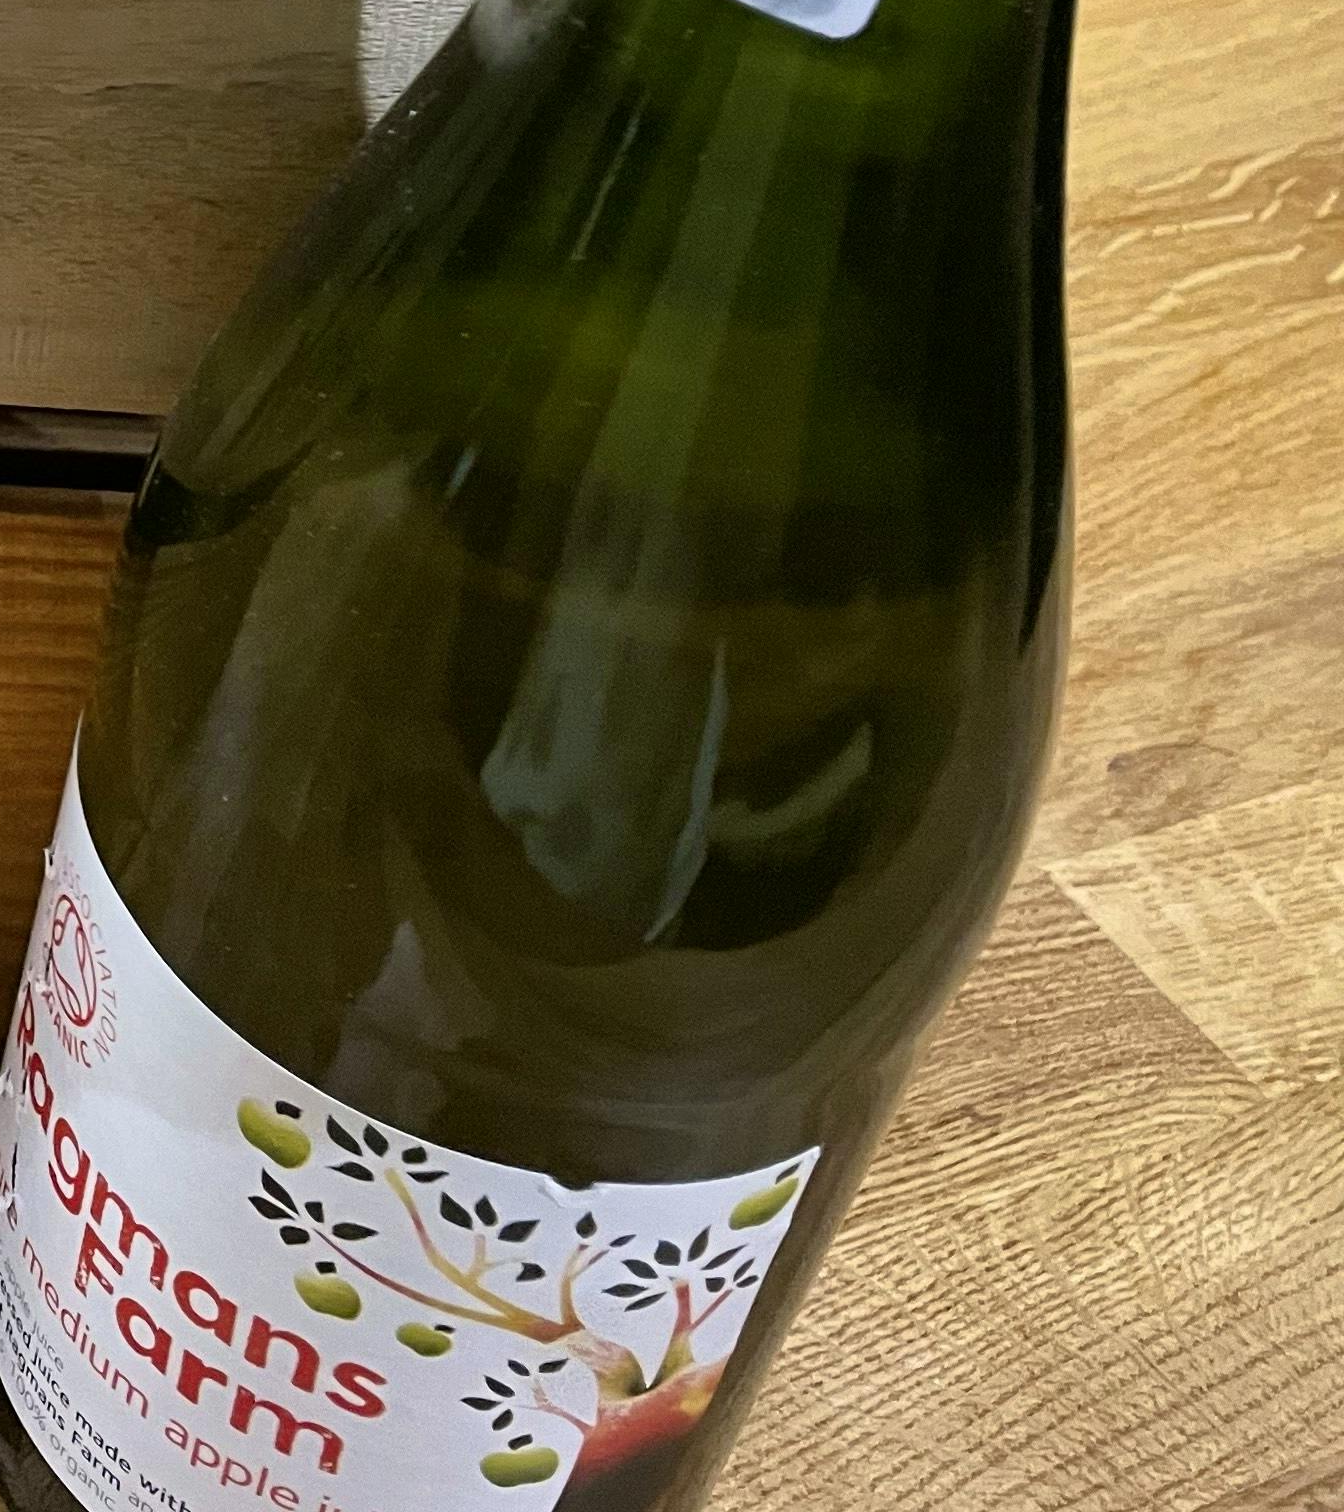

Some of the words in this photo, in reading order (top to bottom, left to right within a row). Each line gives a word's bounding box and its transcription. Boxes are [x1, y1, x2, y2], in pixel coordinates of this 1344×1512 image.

[17, 982, 389, 1418] Ragmans
[5, 1319, 66, 1431] Ragmans
[71, 1430, 121, 1491] Farm
[21, 1237, 148, 1419] medium
[164, 1418, 300, 1512] apple
[29, 1348, 70, 1408] juice
[75, 1410, 131, 1475] made
[74, 1222, 345, 1476] Farm
[49, 1432, 117, 1511] organic
